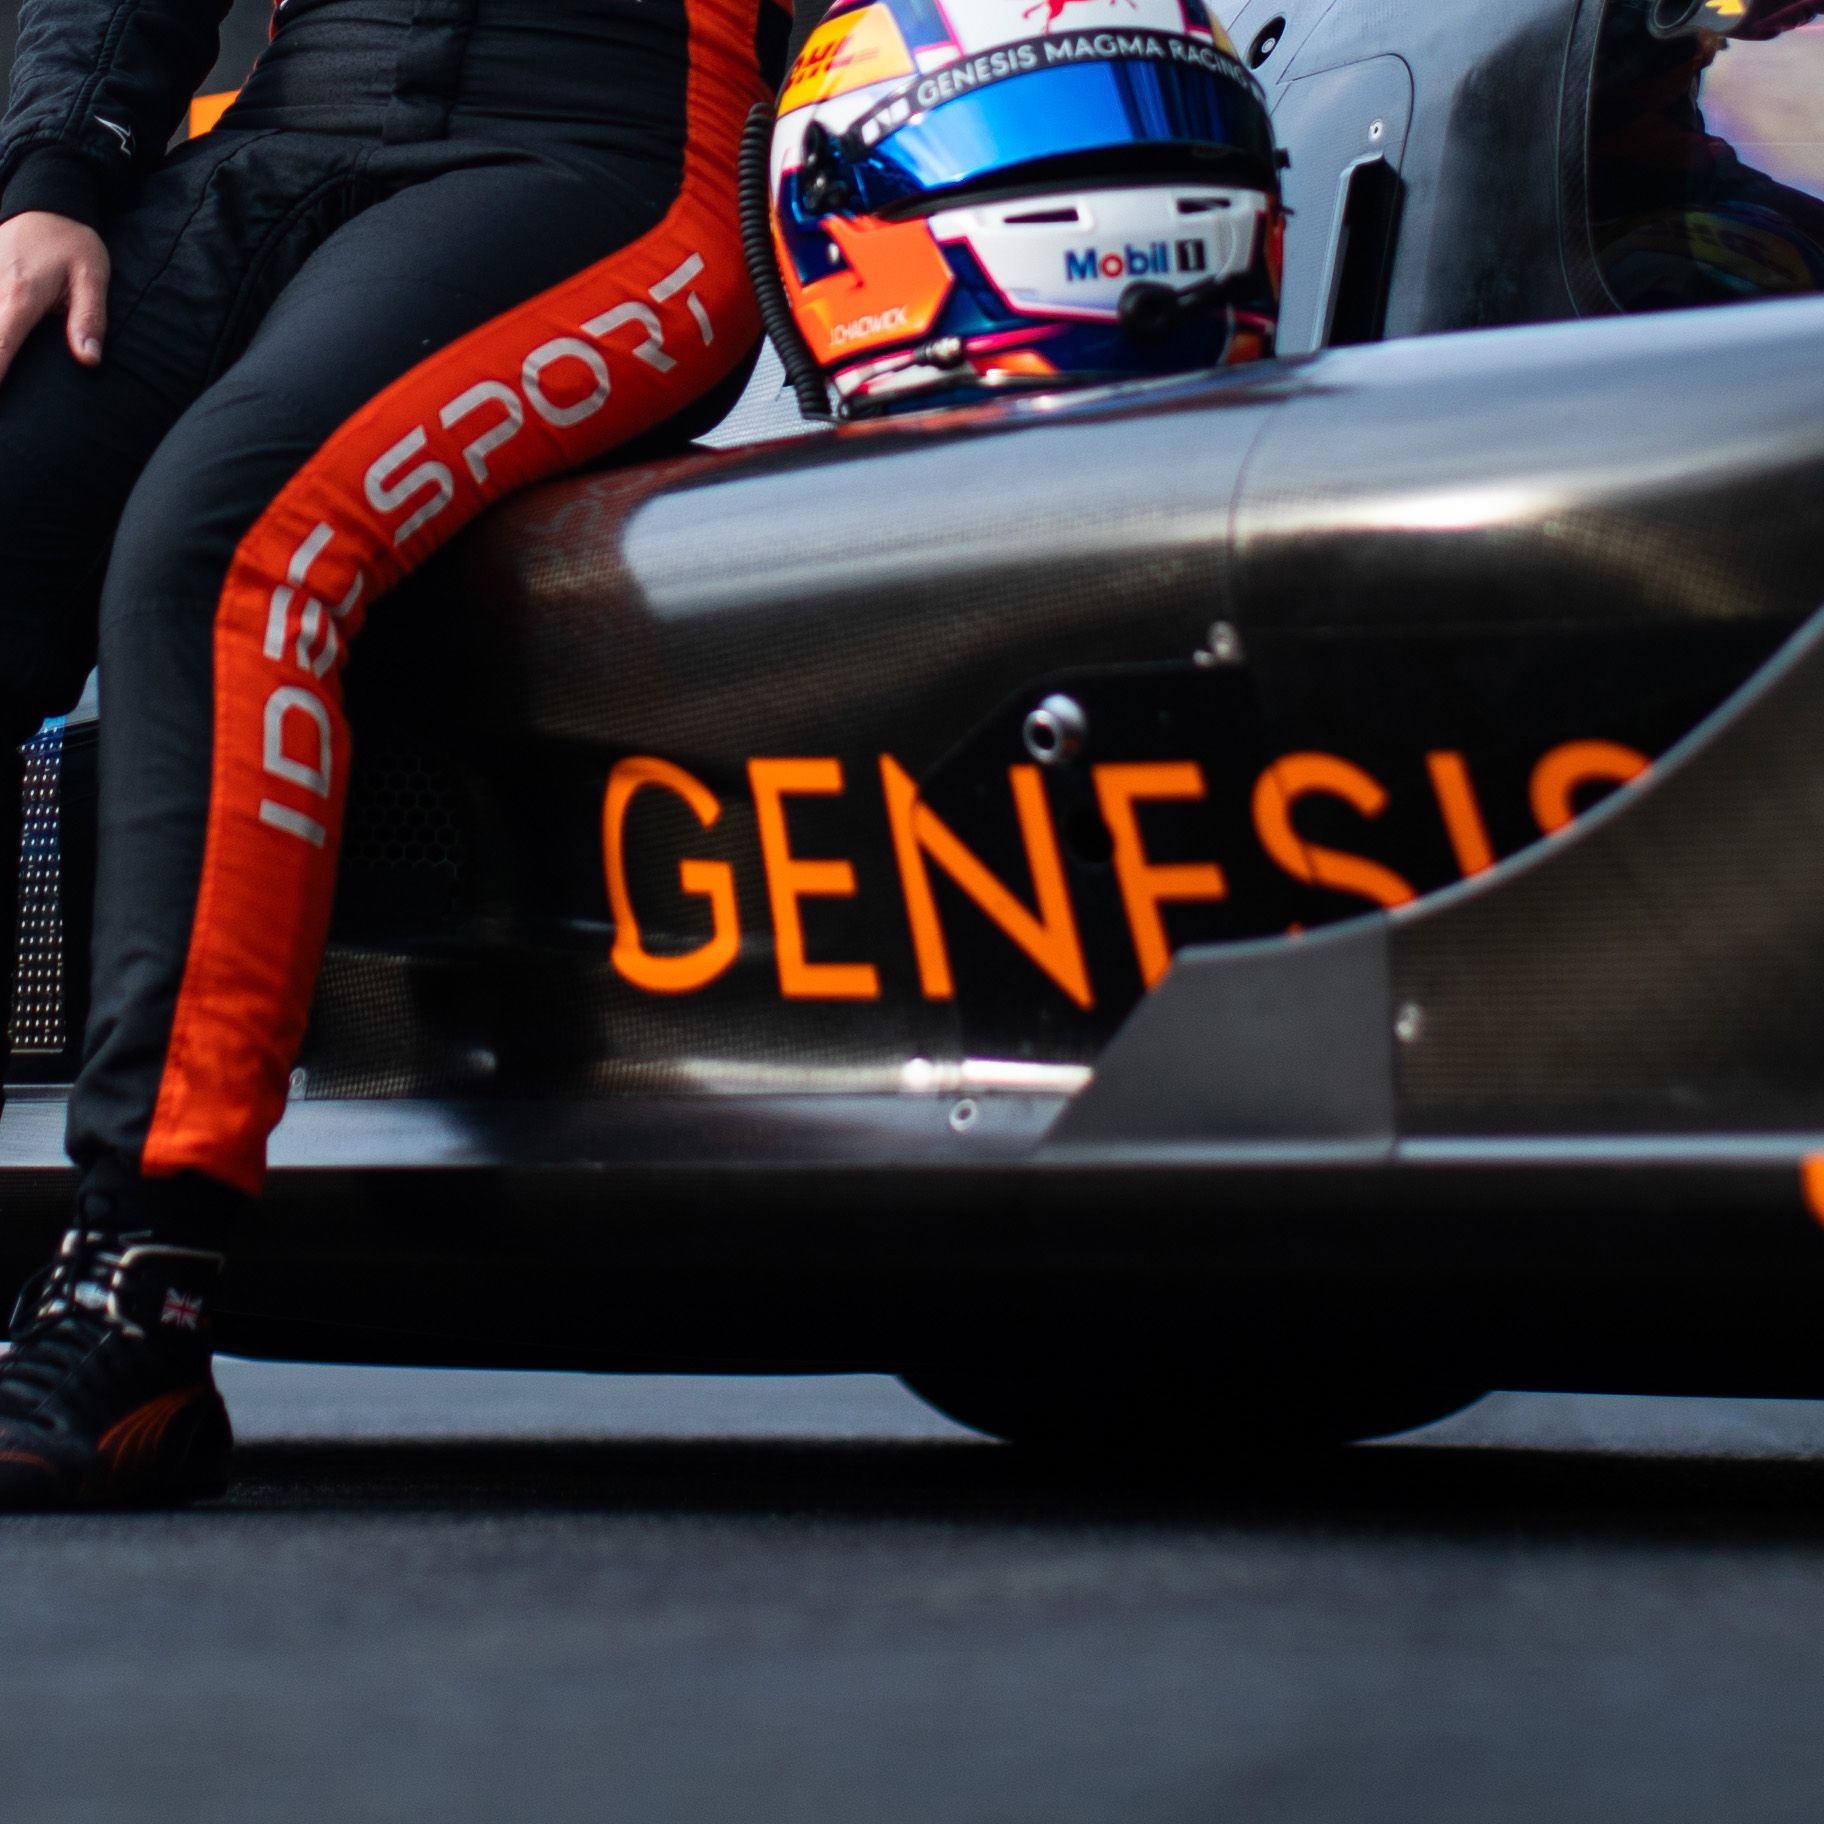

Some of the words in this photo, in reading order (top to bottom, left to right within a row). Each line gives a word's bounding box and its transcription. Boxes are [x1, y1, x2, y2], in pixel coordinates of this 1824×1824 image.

[916, 44, 1039, 107] GENESIS
[1043, 33, 1167, 64] MAGMA
[1064, 238, 1170, 283] Mobil
[363, 251, 714, 546] SPORT
